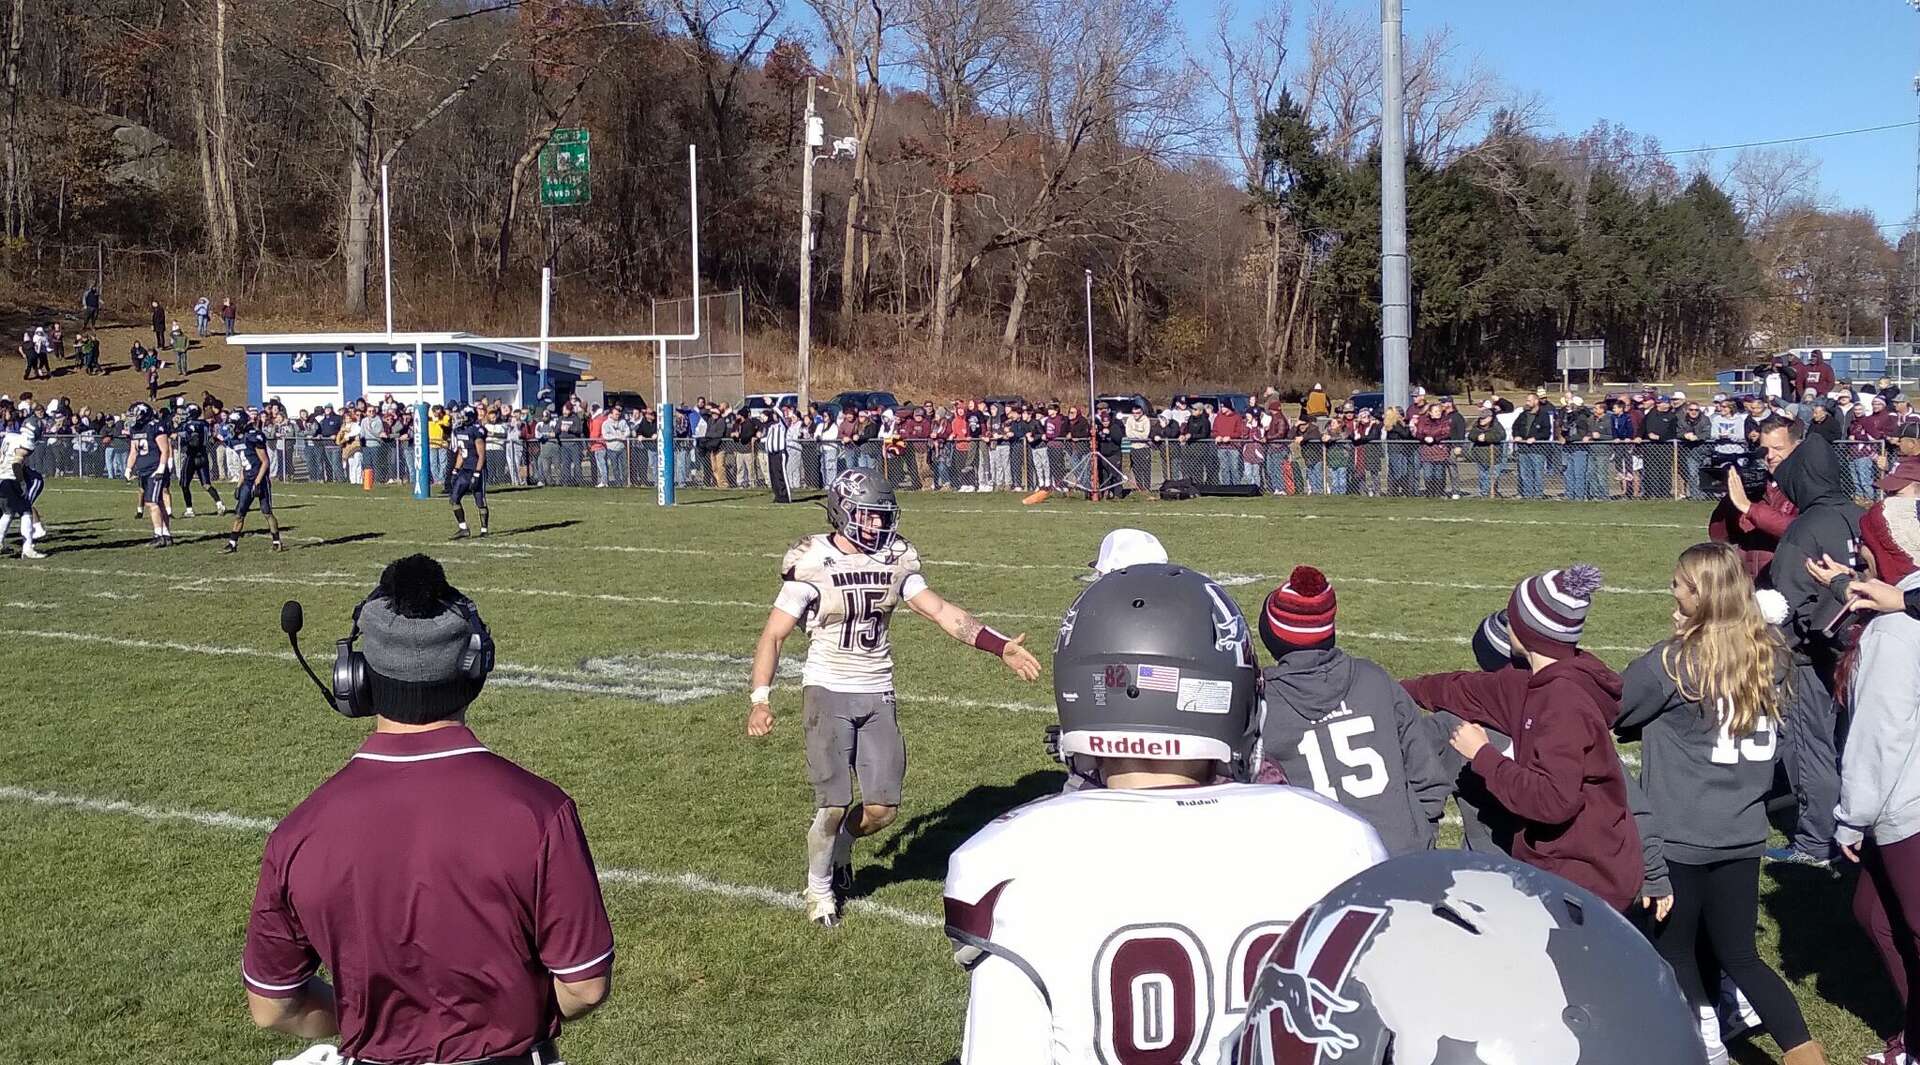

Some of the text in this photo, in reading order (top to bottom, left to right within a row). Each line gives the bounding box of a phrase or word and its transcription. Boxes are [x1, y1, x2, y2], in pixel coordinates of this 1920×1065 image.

[831, 571, 893, 587] NAUGATUCK
[838, 588, 889, 651] 15
[1104, 664, 1127, 688] 82
[1089, 735, 1181, 756] Riddell
[1297, 715, 1390, 802] 15
